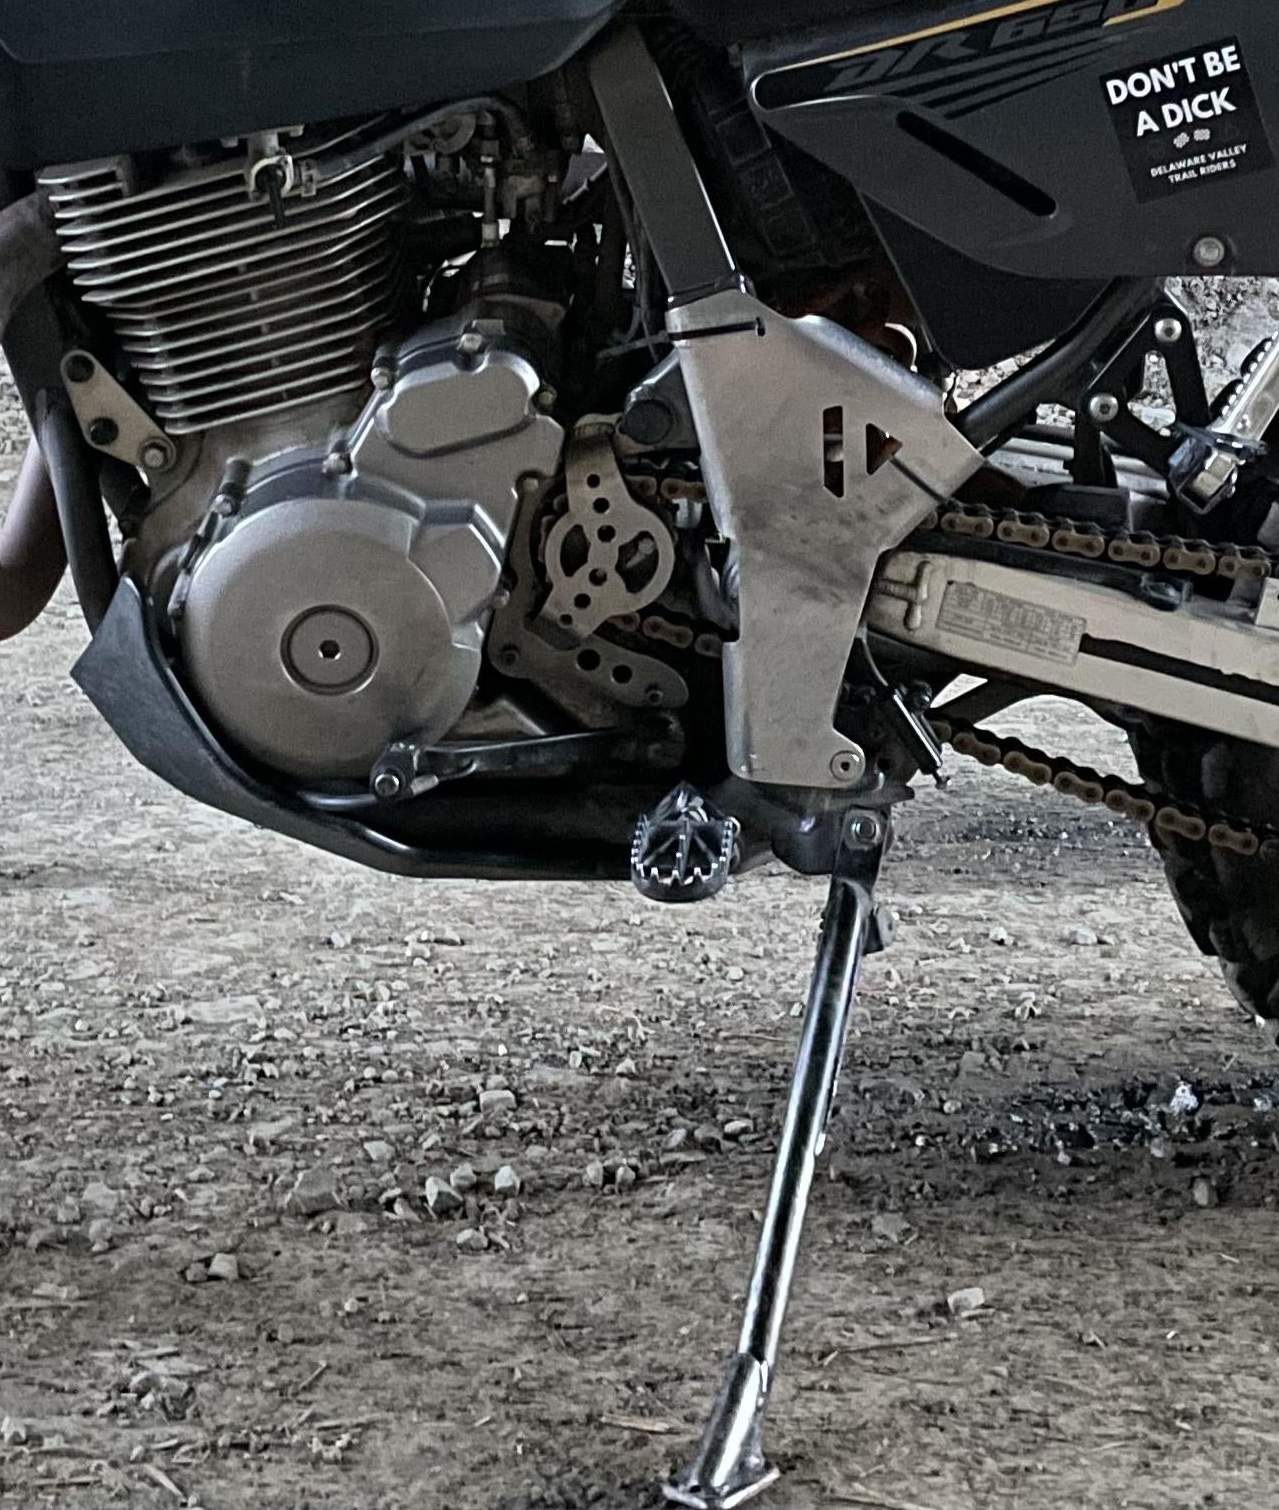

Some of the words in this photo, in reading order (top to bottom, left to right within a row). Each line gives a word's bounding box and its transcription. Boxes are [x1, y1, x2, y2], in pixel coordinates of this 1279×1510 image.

[1105, 56, 1197, 106] DON'T
[1202, 45, 1241, 78] BE
[1136, 110, 1160, 137] A
[1161, 86, 1237, 130] DICK
[1150, 153, 1207, 178] DELAWARE
[1207, 143, 1248, 162] VALLEY
[1167, 169, 1199, 186] TRAIL
[1199, 158, 1237, 177] RIDERS
